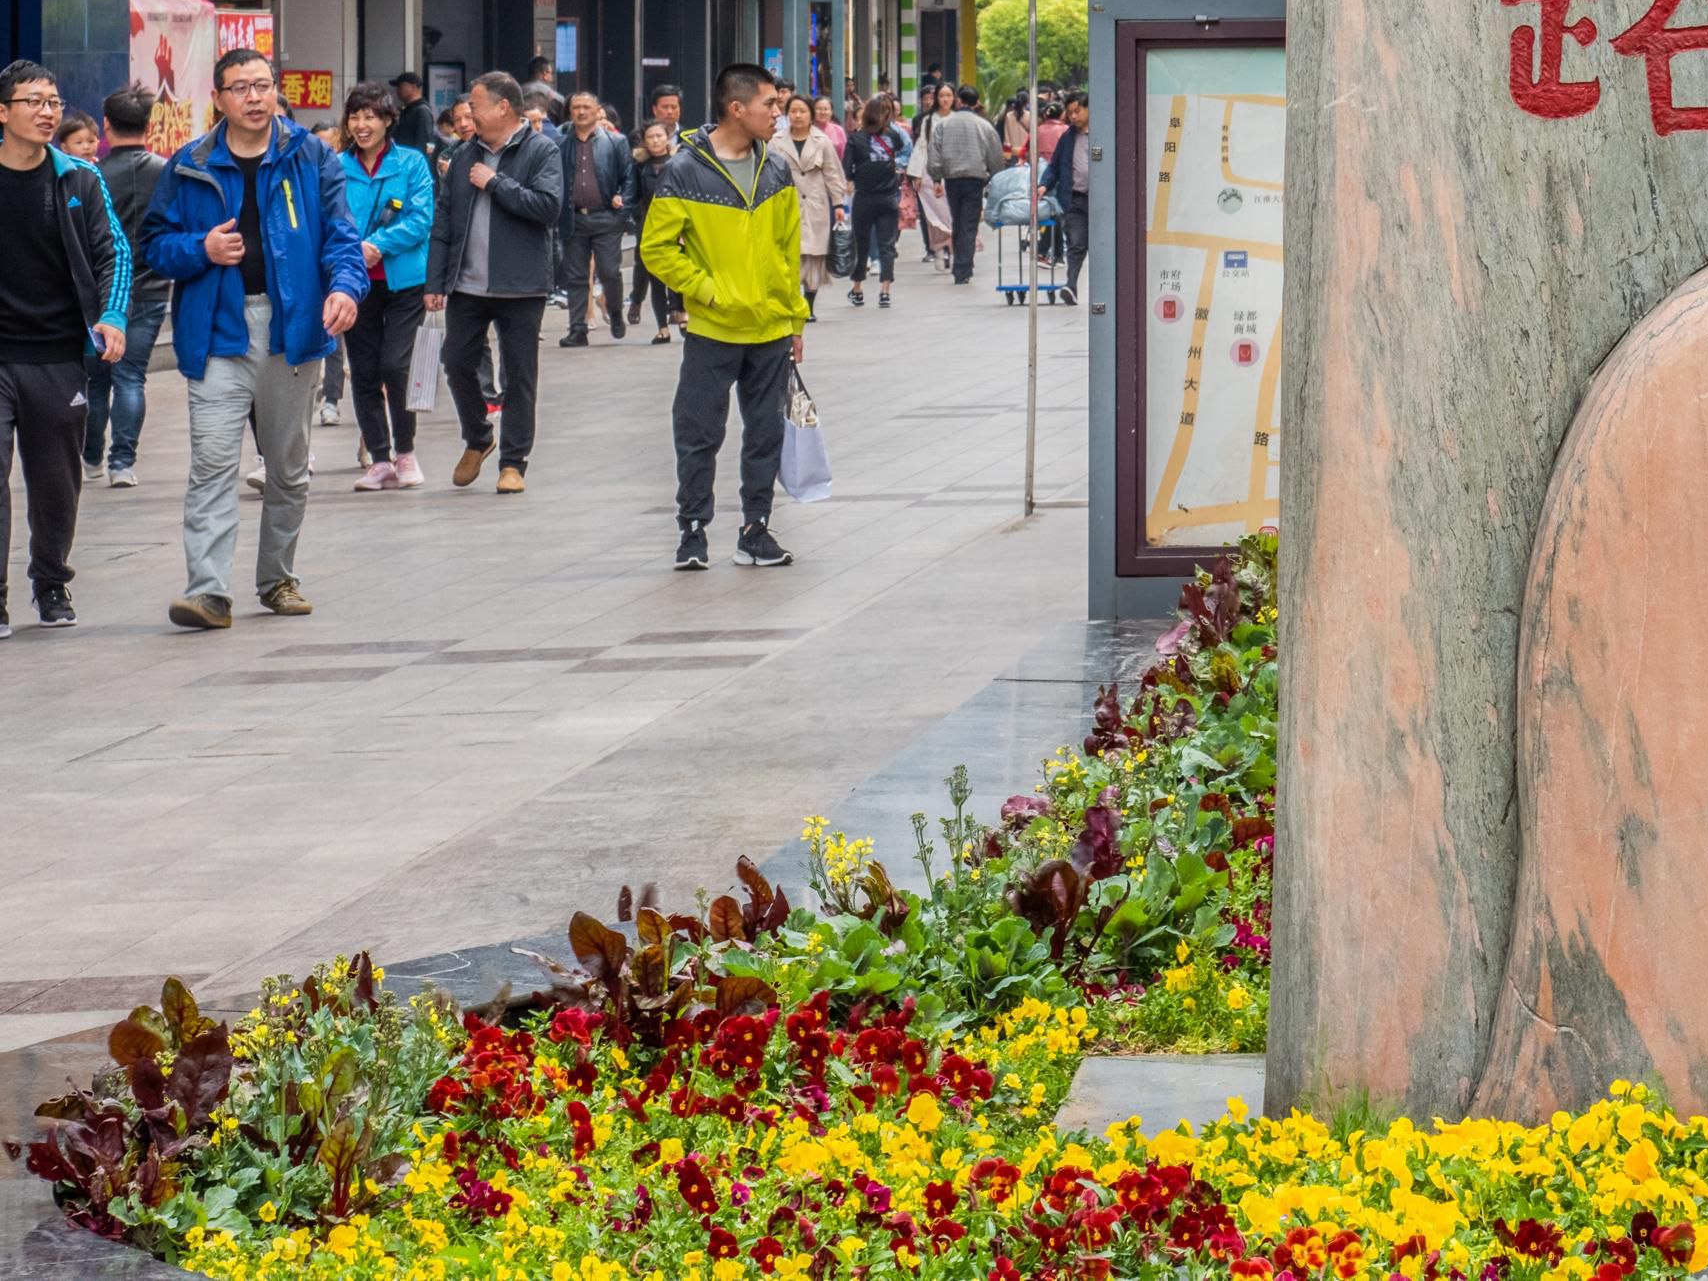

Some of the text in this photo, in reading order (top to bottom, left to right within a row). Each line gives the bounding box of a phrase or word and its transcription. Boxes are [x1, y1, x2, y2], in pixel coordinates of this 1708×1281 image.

[282, 73, 331, 105] 香烟
[1158, 117, 1182, 184] 阜阳路
[1159, 270, 1181, 280] 市府
[1222, 269, 1250, 278] 公交站
[1159, 281, 1181, 292] 广场
[1234, 310, 1258, 321] 绿都
[1234, 323, 1258, 335] 商城
[1179, 306, 1209, 426] 徽州大道
[1254, 431, 1269, 447] 路
